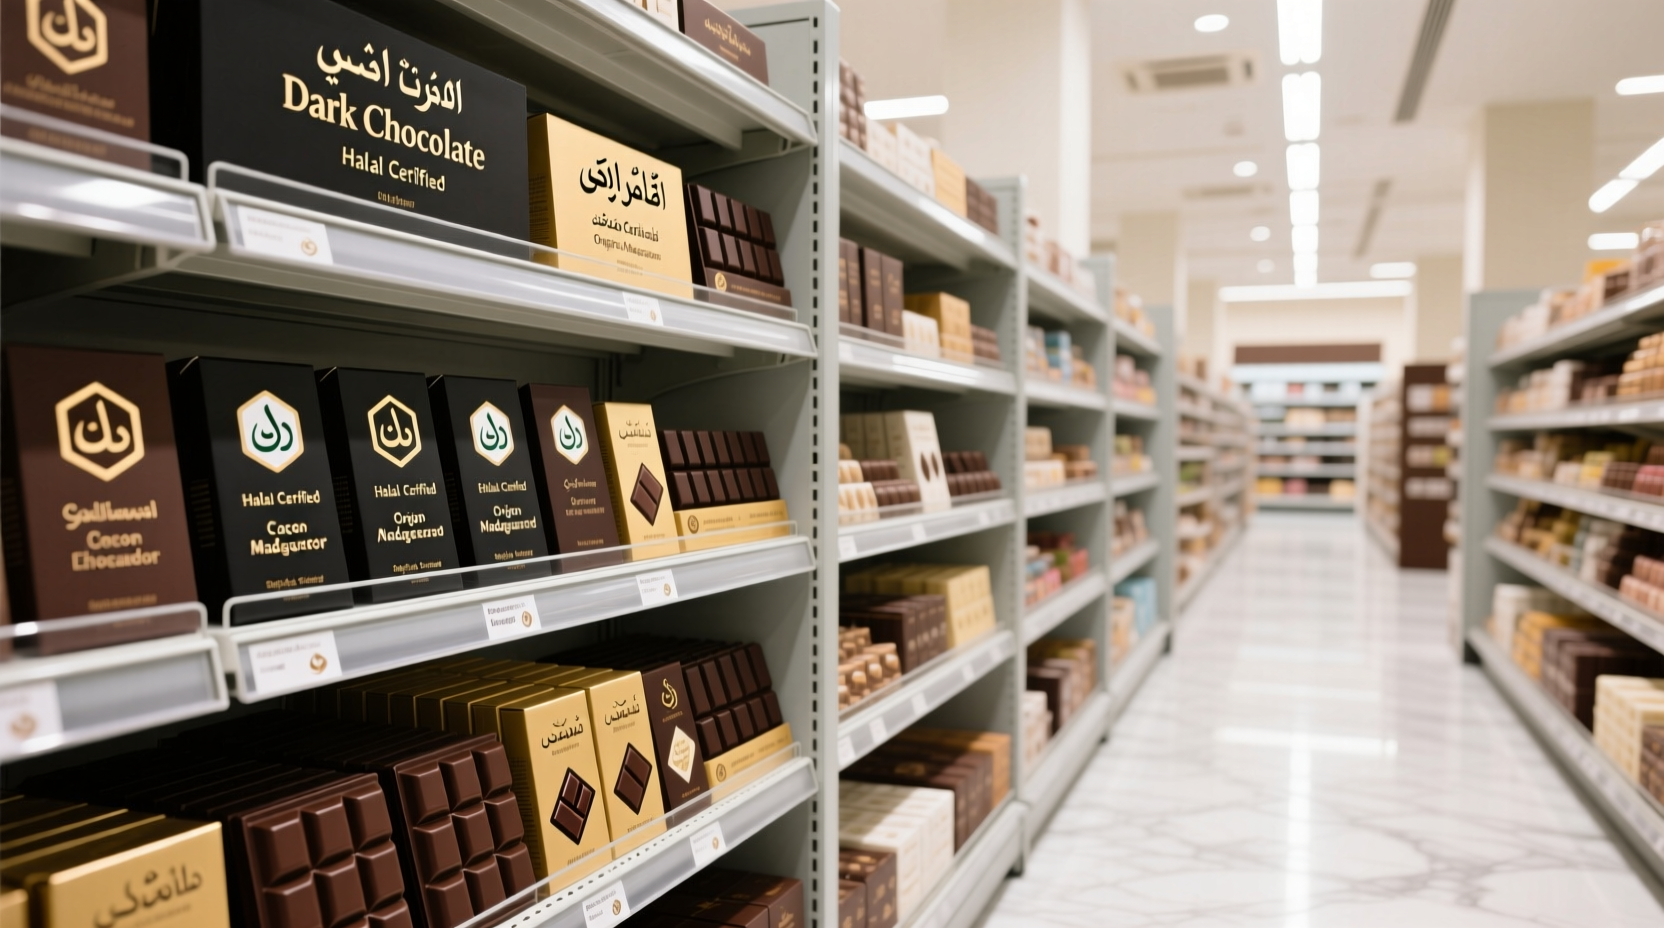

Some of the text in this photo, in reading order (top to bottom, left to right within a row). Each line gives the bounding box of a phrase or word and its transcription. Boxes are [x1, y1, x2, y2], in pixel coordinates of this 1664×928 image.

[282, 73, 486, 170] Dark Chocolate
[342, 146, 384, 176] Halal
[241, 491, 275, 507] Halal
